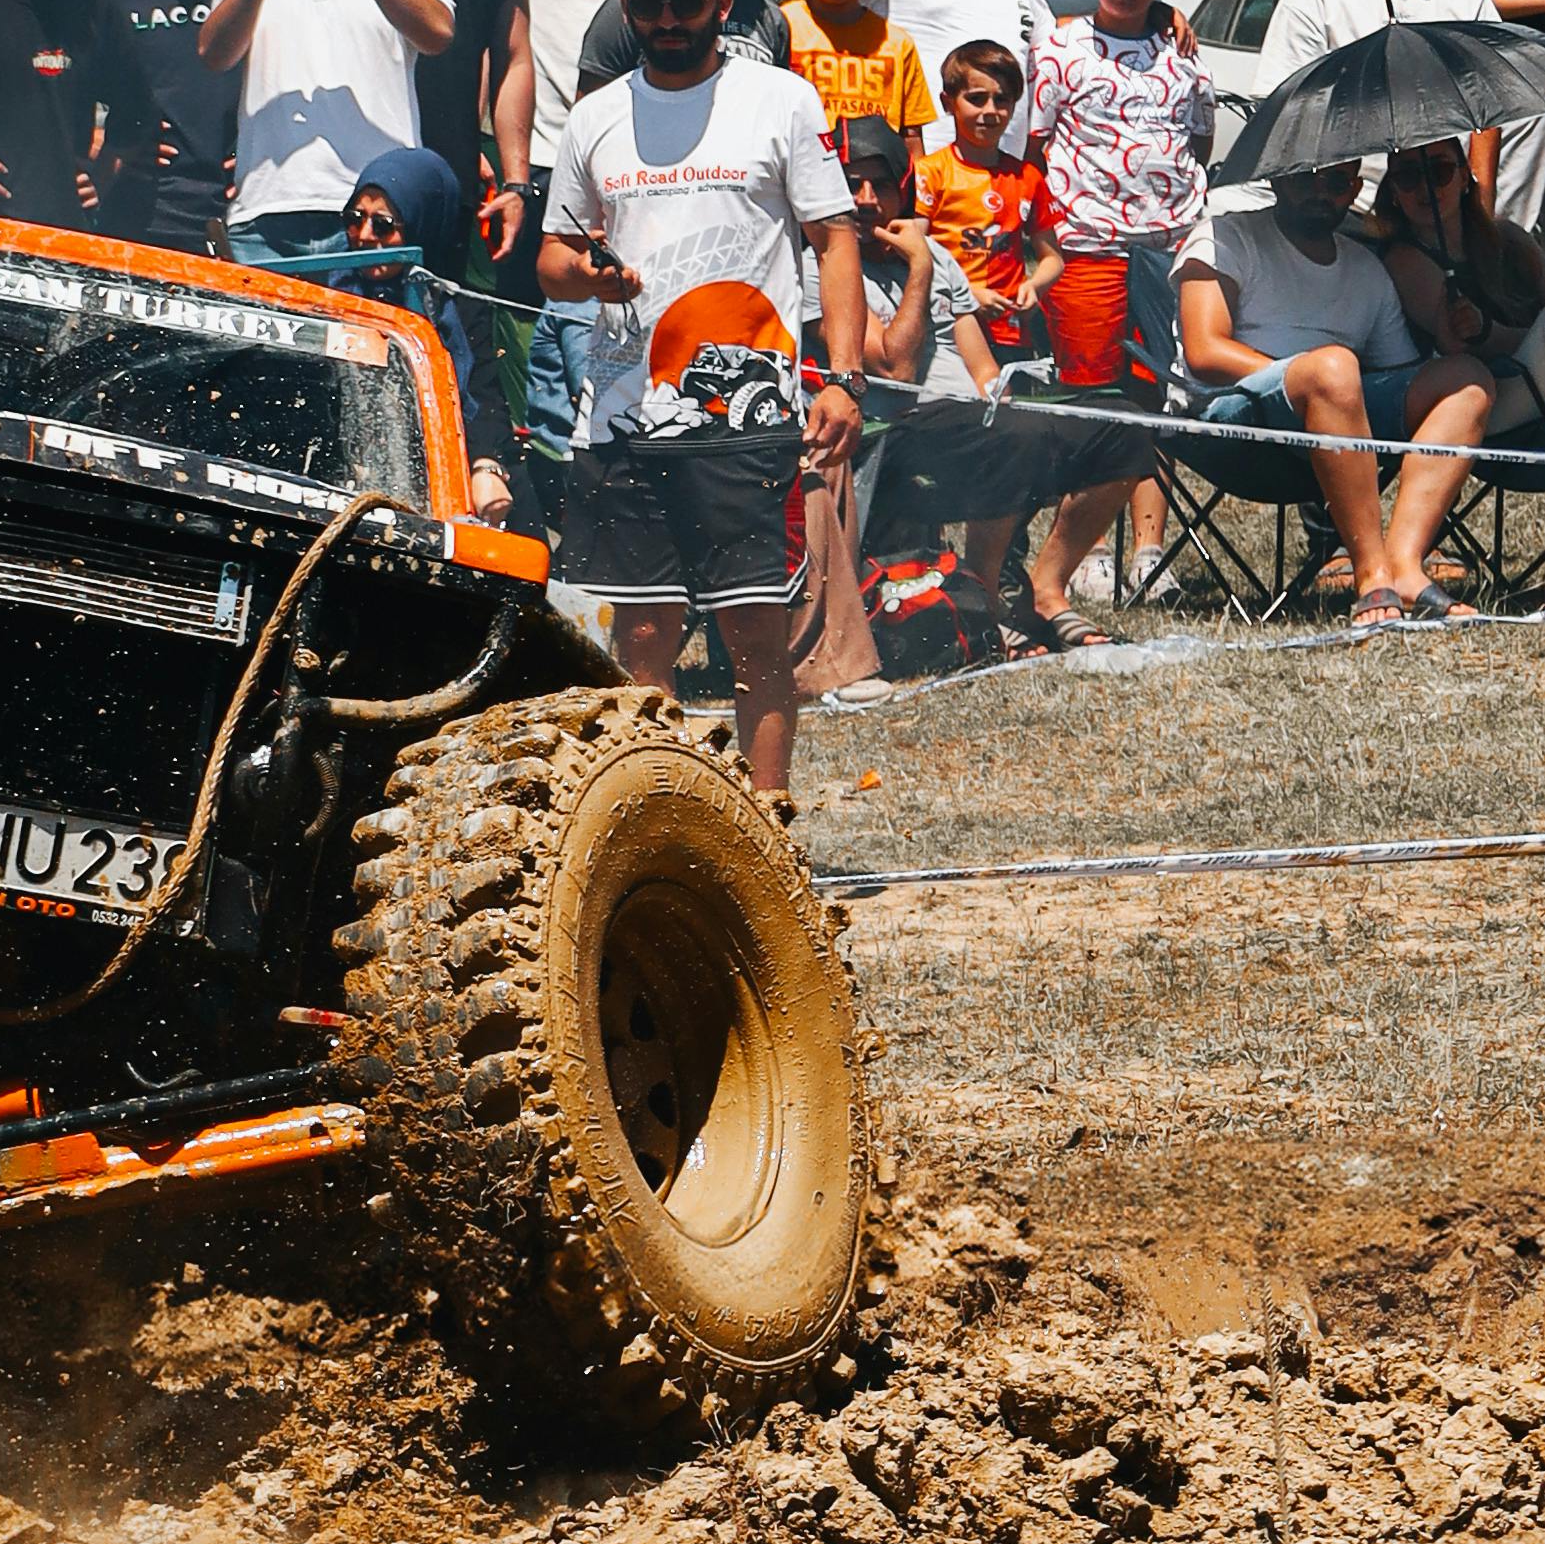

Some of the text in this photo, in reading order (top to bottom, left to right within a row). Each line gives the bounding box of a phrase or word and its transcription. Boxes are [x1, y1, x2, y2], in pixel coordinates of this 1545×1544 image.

[130, 3, 212, 30] LACO
[823, 98, 890, 117] ATASARAY
[604, 165, 748, 193] Soft Road Outdoor
[96, 285, 306, 346] TURKEY
[43, 424, 187, 470] OFF
[16, 895, 77, 918] OTO
